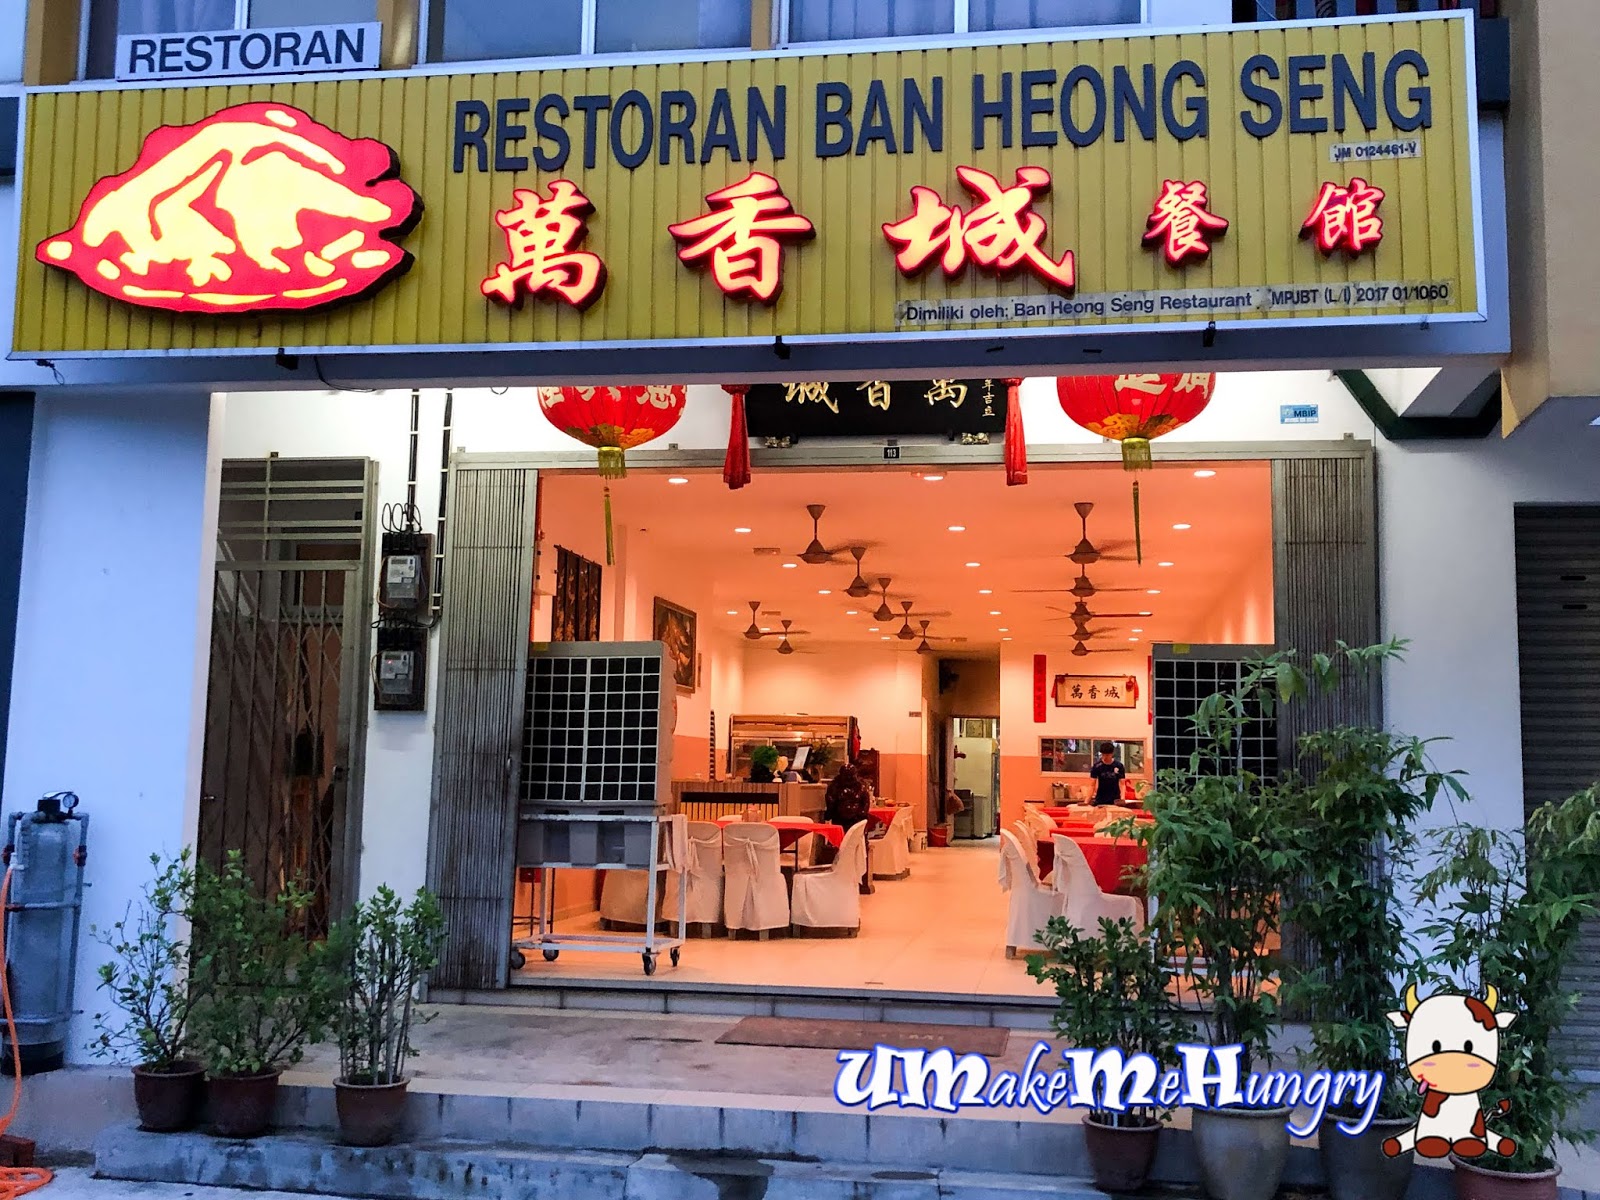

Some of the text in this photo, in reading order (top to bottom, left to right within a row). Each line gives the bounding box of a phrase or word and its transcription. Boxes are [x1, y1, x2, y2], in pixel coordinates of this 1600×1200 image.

[129, 28, 365, 73] RESTORAN
[453, 48, 1432, 173] RESTORAN BAN HEONG SENG
[1335, 147, 1351, 158] JM
[906, 304, 964, 321] Dimiliki
[1014, 302, 1047, 317] Ban
[1050, 299, 1105, 316] Heong
[1111, 296, 1154, 313] Seng
[1159, 292, 1252, 310] Restaurant
[1271, 288, 1318, 306] MPJBT
[1356, 286, 1389, 302] 2017
[1392, 284, 1449, 301] 01/1060
[886, 448, 897, 458] 113
[1070, 684, 1121, 699] 萬香城
